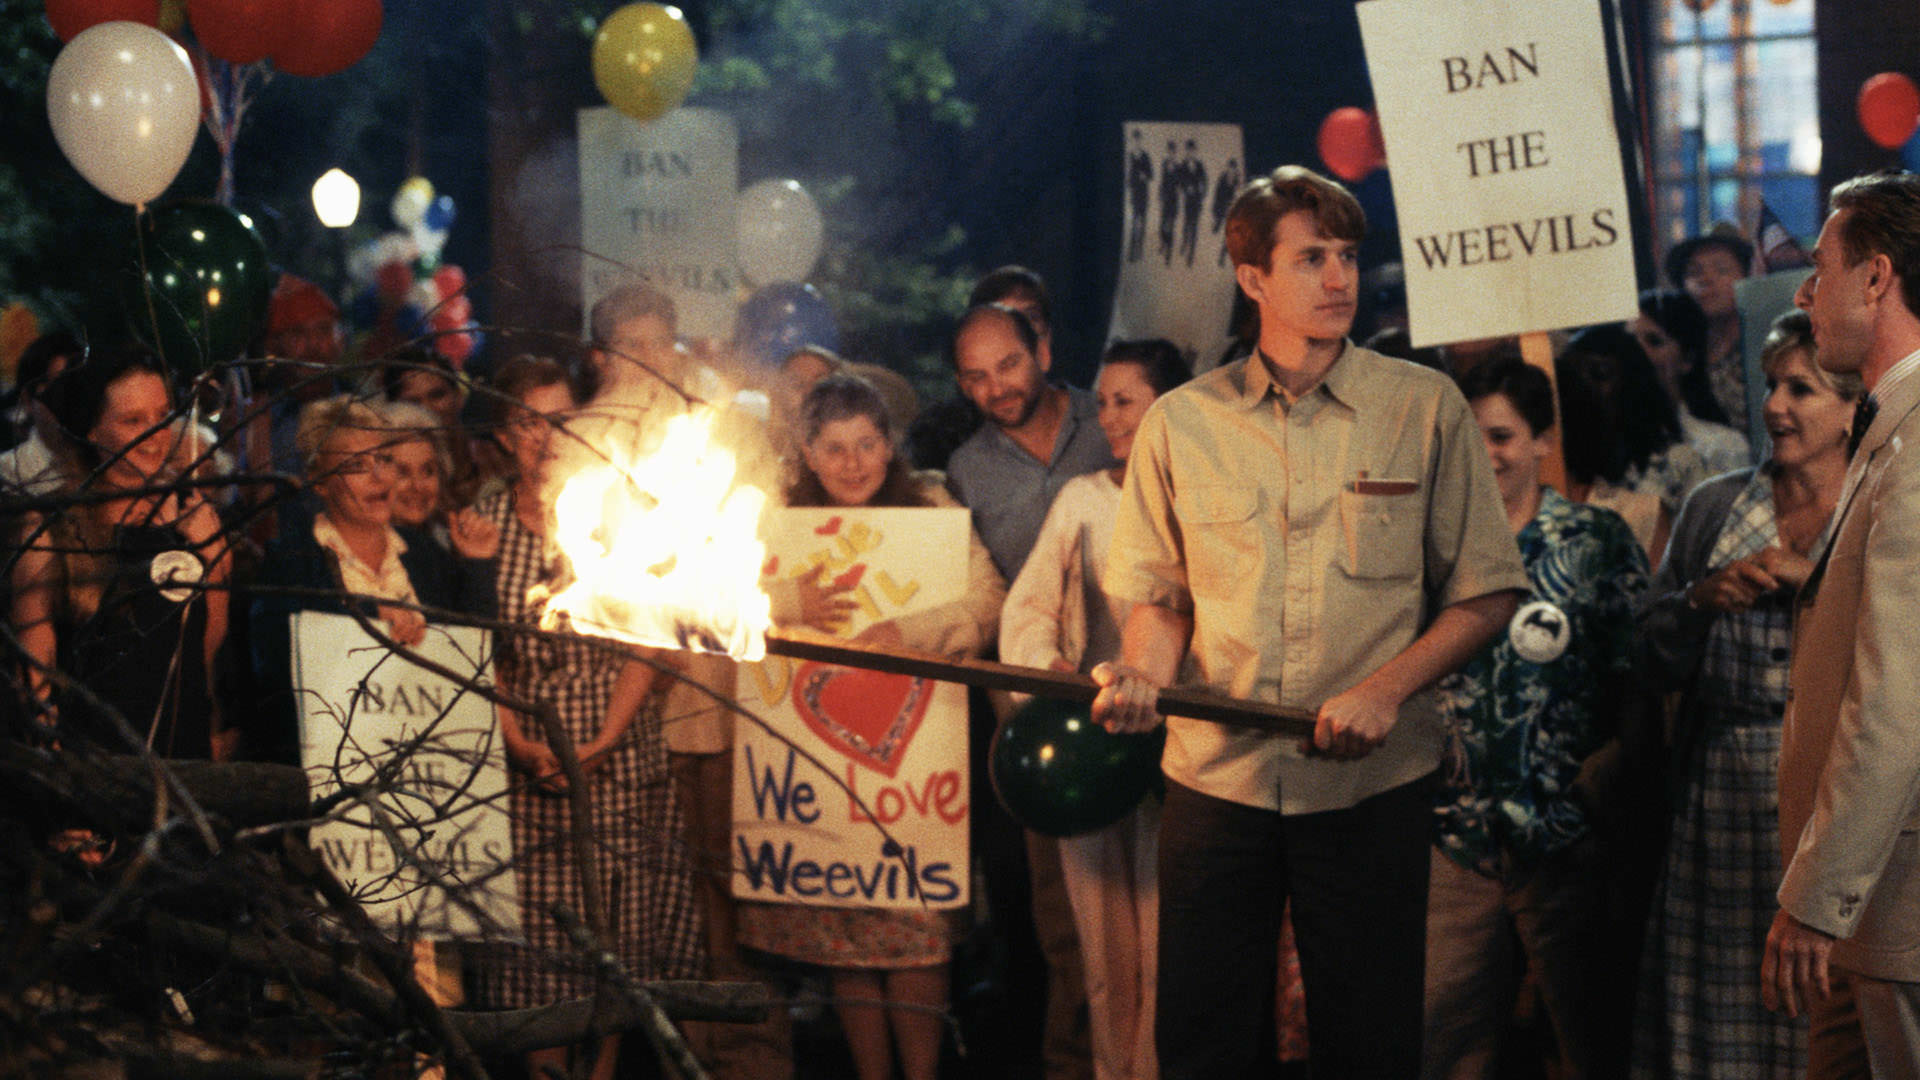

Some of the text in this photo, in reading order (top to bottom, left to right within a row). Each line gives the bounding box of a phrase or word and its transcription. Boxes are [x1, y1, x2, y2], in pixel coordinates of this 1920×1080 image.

[1442, 42, 1540, 94] BAN
[621, 151, 692, 178] BAN
[1457, 131, 1549, 178] THE
[1414, 208, 1618, 271] WEEVILS
[358, 682, 444, 716] BAN
[376, 760, 446, 795] HE
[745, 744, 968, 826] We Love
[322, 837, 504, 874] WEVILS
[737, 834, 960, 902] Weevils
